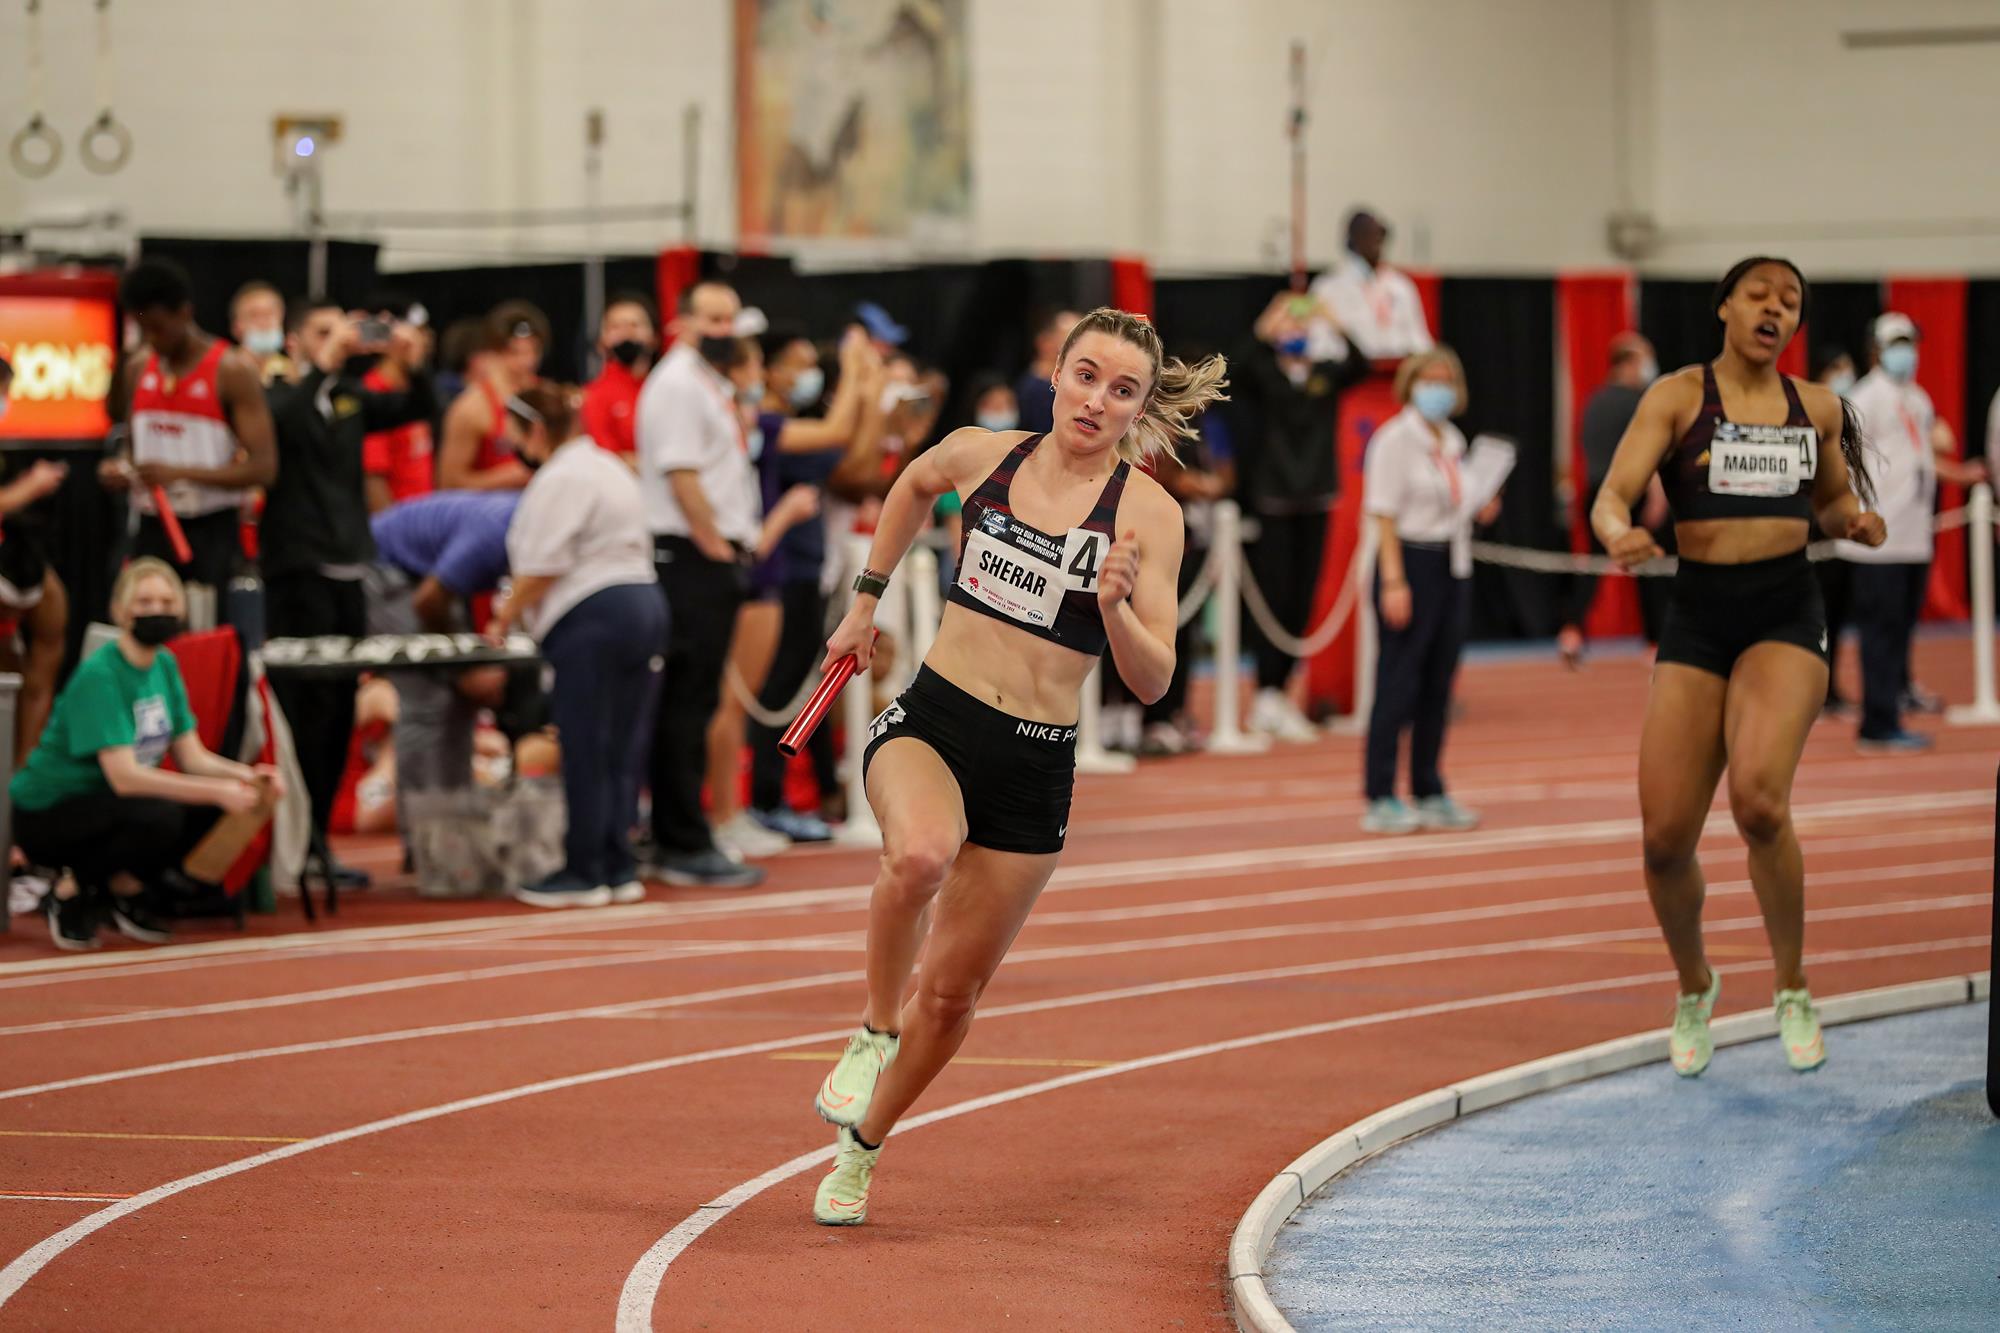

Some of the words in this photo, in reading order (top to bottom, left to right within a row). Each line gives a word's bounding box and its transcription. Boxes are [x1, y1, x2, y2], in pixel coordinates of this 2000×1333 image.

[1009, 524, 1024, 536] 2022
[1034, 535, 1052, 549] TRACK
[1015, 536, 1058, 561] CHAMPIONSHIPS
[979, 549, 1047, 598] SHERAR
[1067, 535, 1099, 589] 4
[1016, 721, 1061, 742] NIKE
